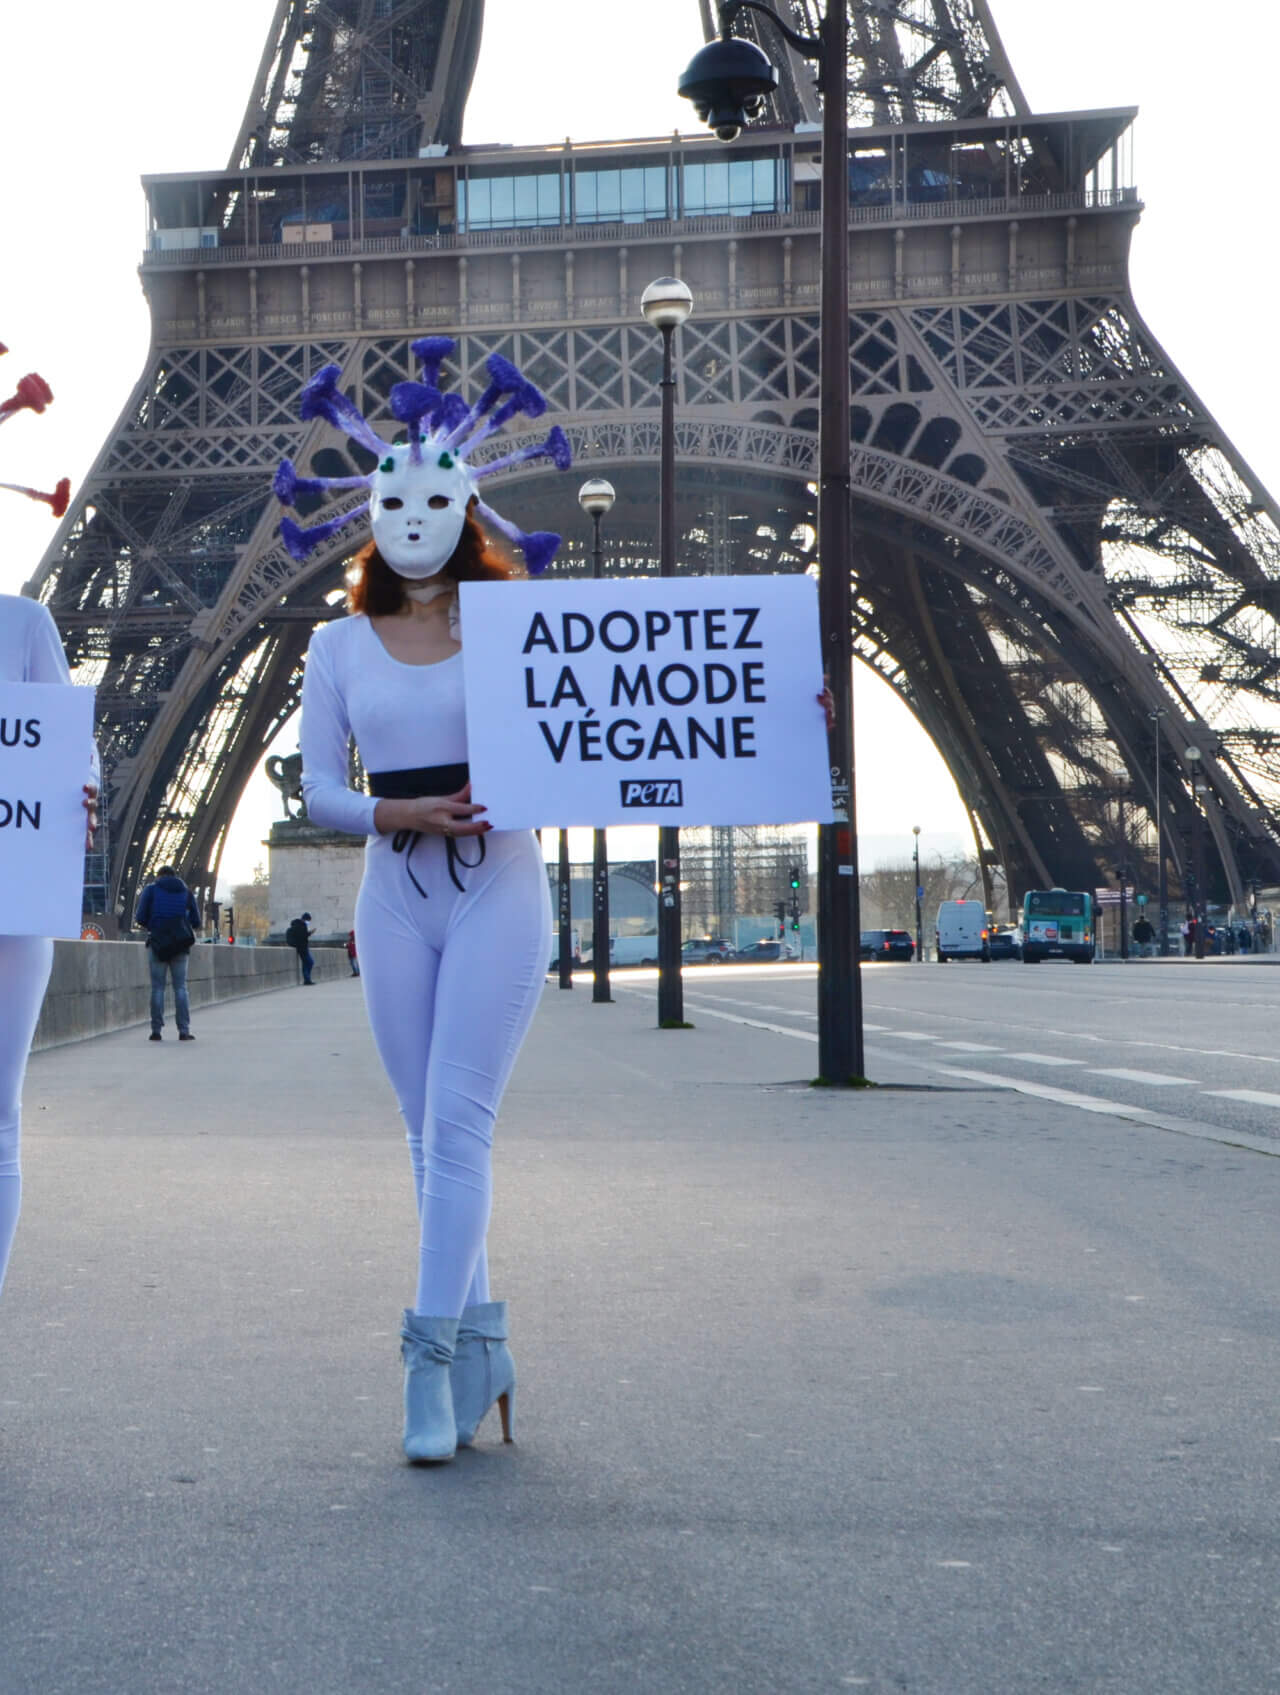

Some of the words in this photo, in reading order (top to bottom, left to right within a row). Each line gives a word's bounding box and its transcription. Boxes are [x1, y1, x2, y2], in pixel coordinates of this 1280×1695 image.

[522, 608, 763, 654] ADOPTEZ
[525, 666, 587, 708] LA
[611, 662, 766, 707] MODE
[539, 708, 756, 763] VÉGANE
